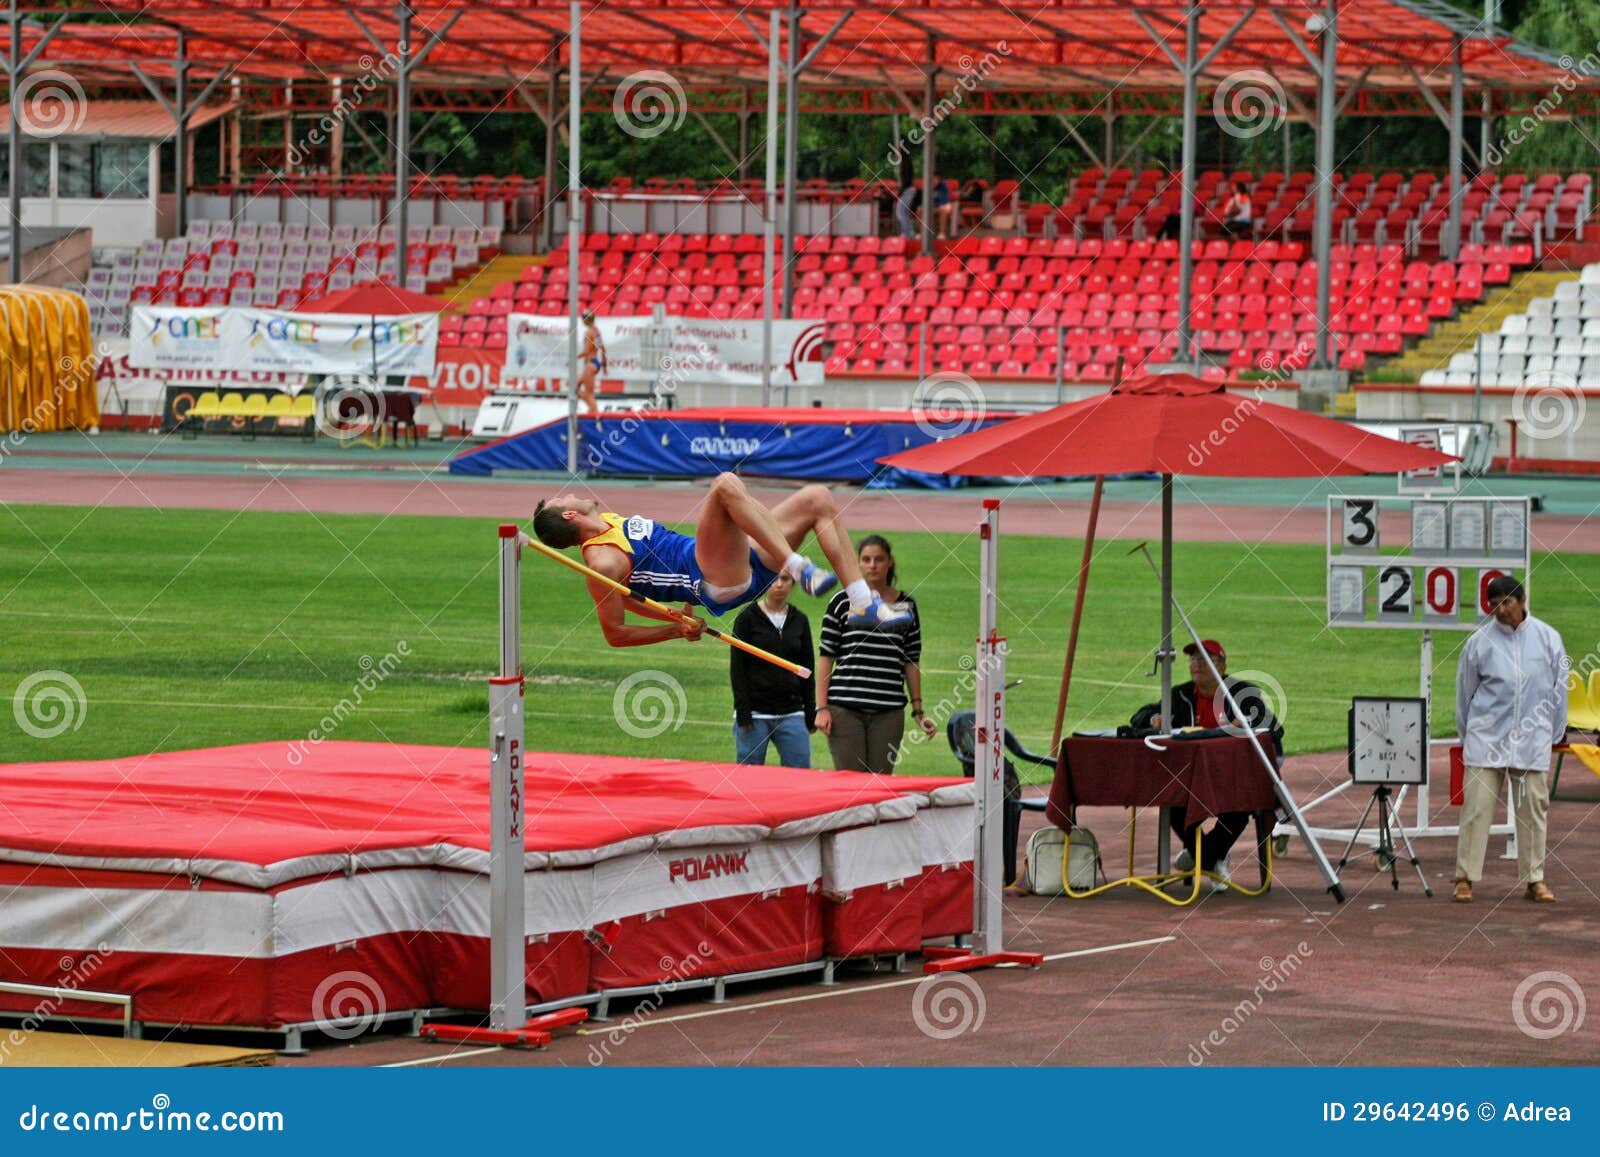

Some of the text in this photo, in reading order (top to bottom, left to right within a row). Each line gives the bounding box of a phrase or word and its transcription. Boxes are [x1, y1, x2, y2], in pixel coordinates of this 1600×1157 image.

[1346, 500, 1376, 545] 3
[993, 691, 1002, 781] POLANIK
[510, 739, 520, 838] POLANIK
[669, 851, 749, 884] POLANIK
